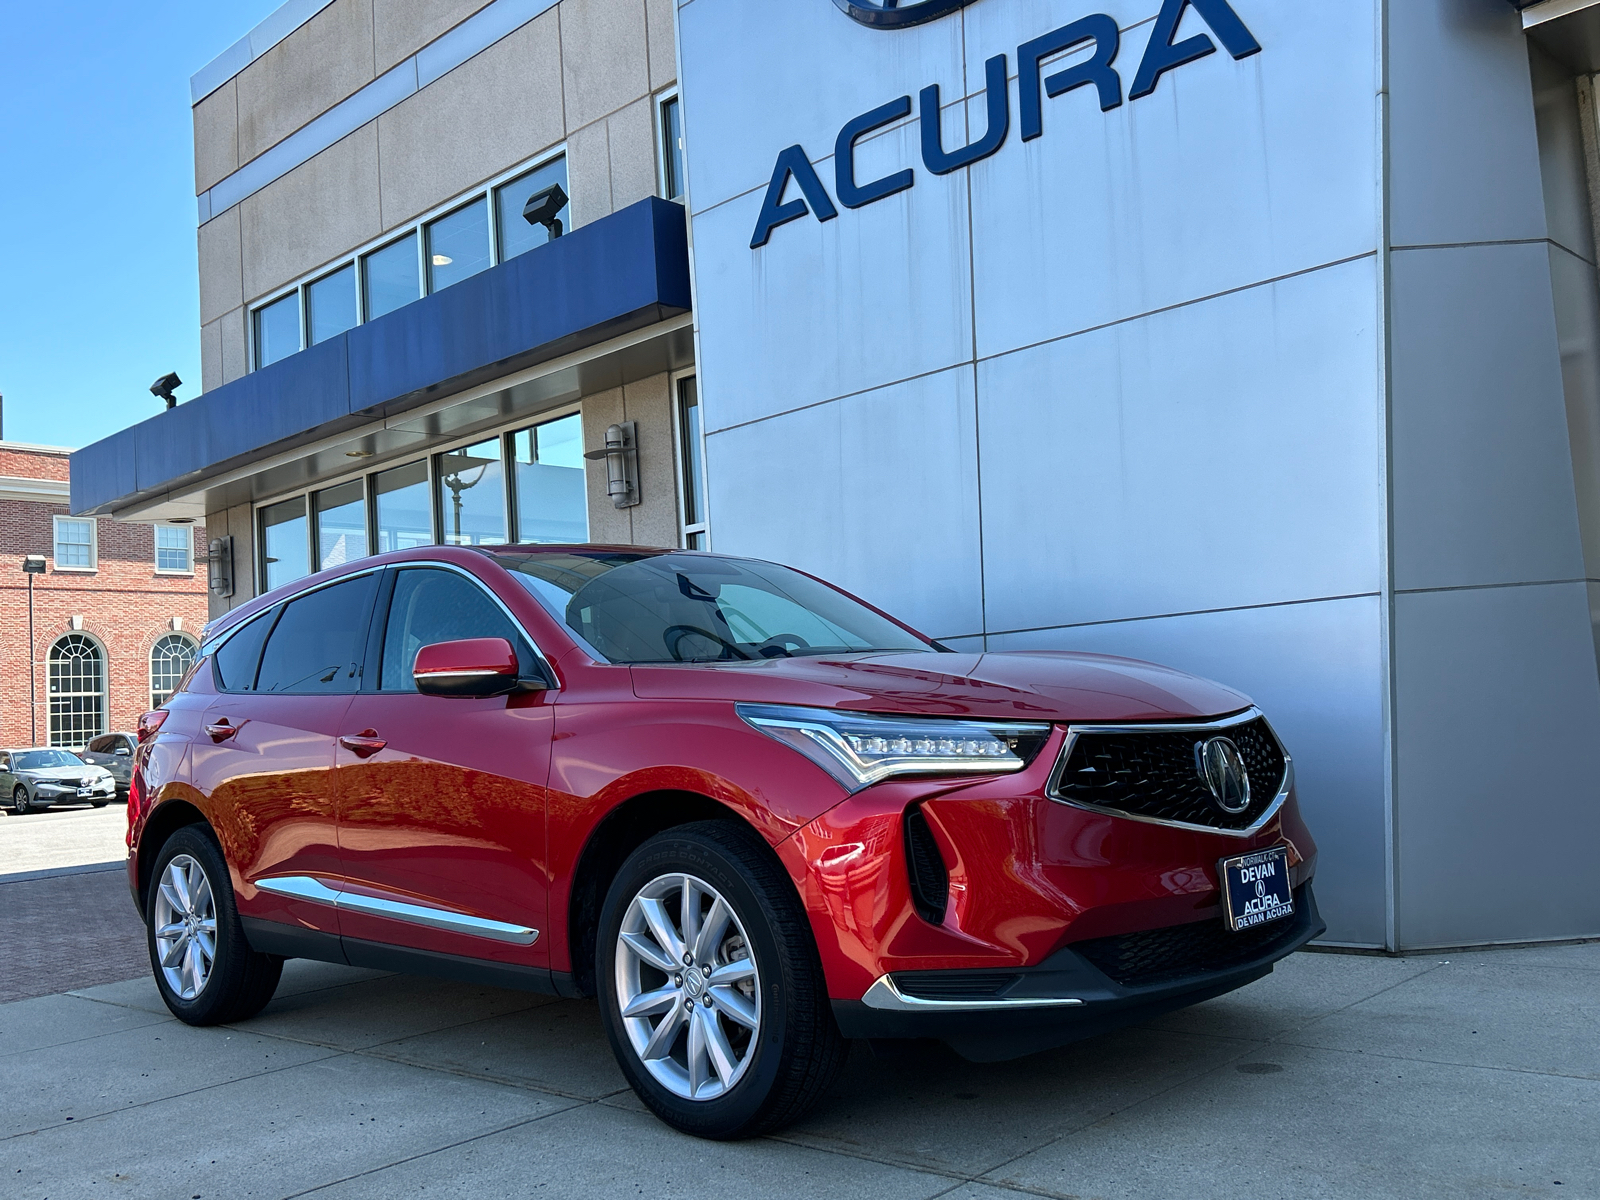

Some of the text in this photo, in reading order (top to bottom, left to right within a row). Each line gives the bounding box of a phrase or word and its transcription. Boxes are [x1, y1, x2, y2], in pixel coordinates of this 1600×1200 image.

[750, 0, 1262, 249] ACURA
[1241, 862, 1275, 884] DEVAN
[1244, 893, 1280, 915] ACURA
[1237, 904, 1293, 928] DEVAN ACURA
